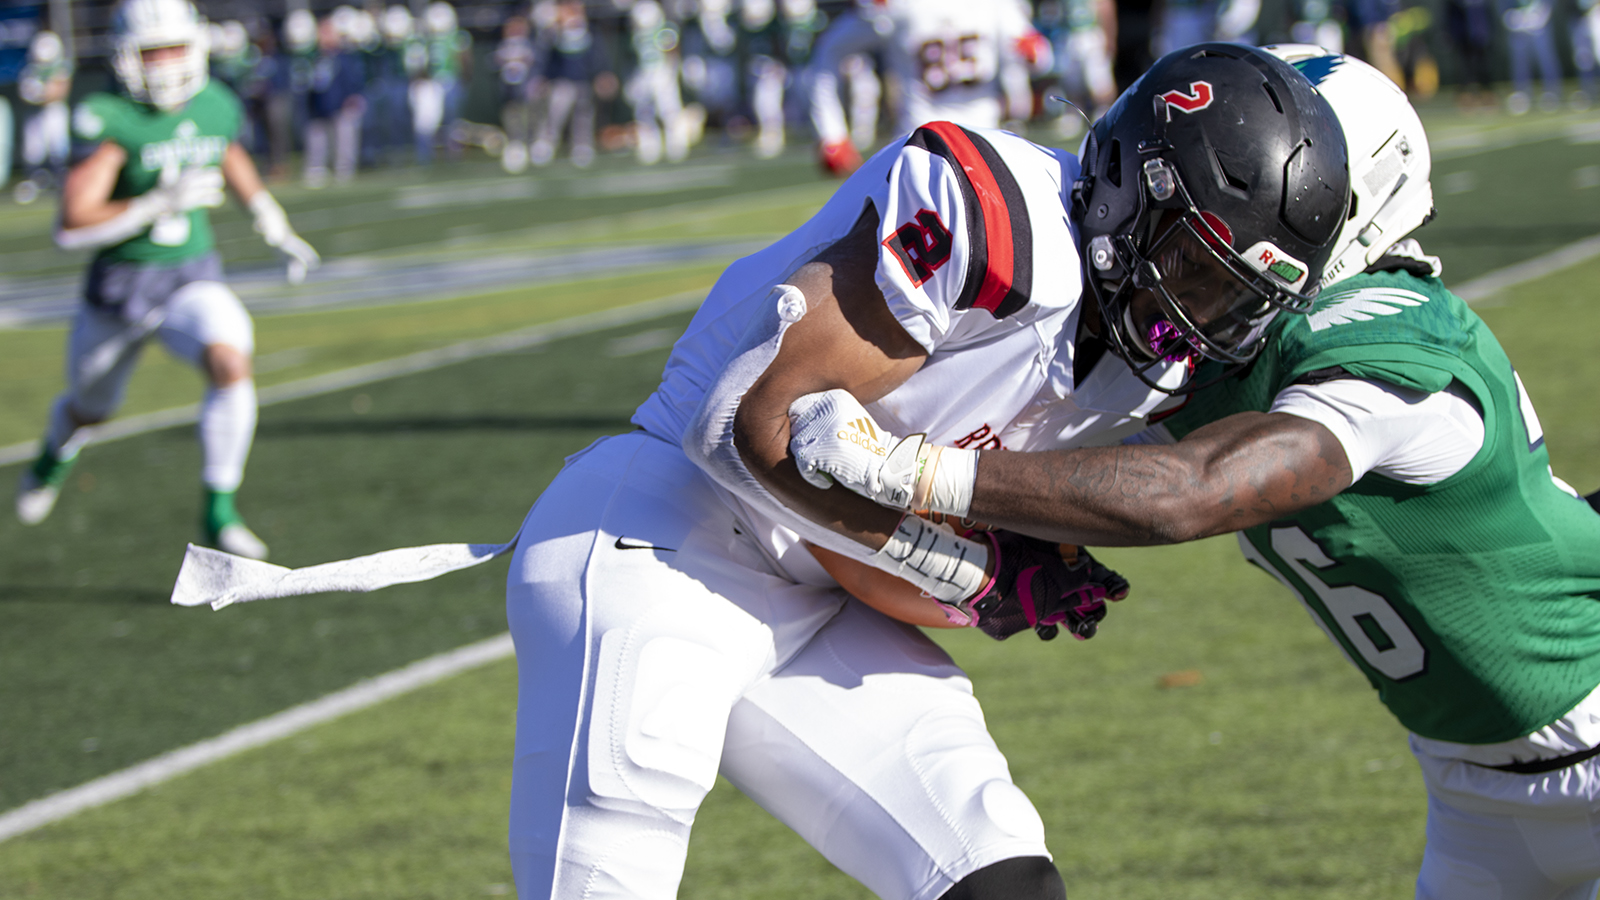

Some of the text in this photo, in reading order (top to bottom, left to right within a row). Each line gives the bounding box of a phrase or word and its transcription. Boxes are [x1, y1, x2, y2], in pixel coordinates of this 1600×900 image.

[920, 34, 980, 90] 85
[1160, 80, 1214, 123] 2
[881, 207, 953, 289] 2
[837, 430, 886, 457] adidas
